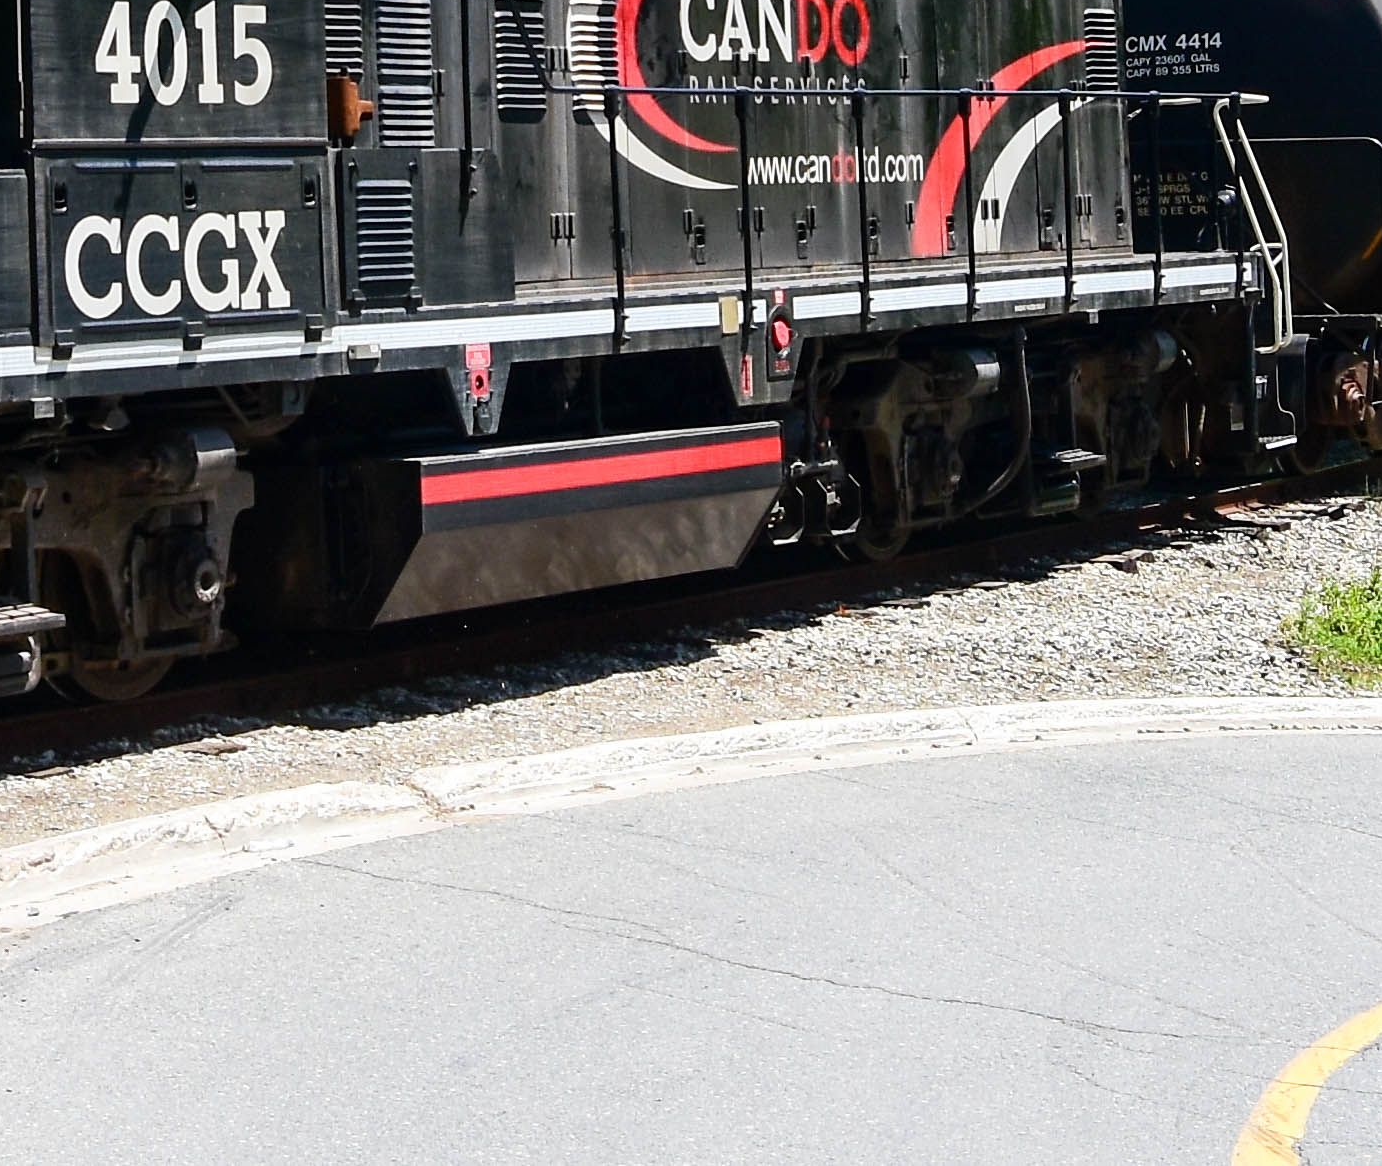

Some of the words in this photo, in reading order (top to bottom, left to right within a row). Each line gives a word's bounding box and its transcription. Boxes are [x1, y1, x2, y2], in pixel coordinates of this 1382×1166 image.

[1175, 32, 1223, 49] 4414
[95, 0, 273, 106] 4015
[1126, 57, 1151, 67] CAPY
[1191, 53, 1212, 63] GAL
[1126, 68, 1151, 78] CAPY
[1155, 67, 1168, 76] 89
[1172, 65, 1191, 75] 355
[1195, 64, 1220, 73] LTRS
[64, 210, 291, 319] CCGX
